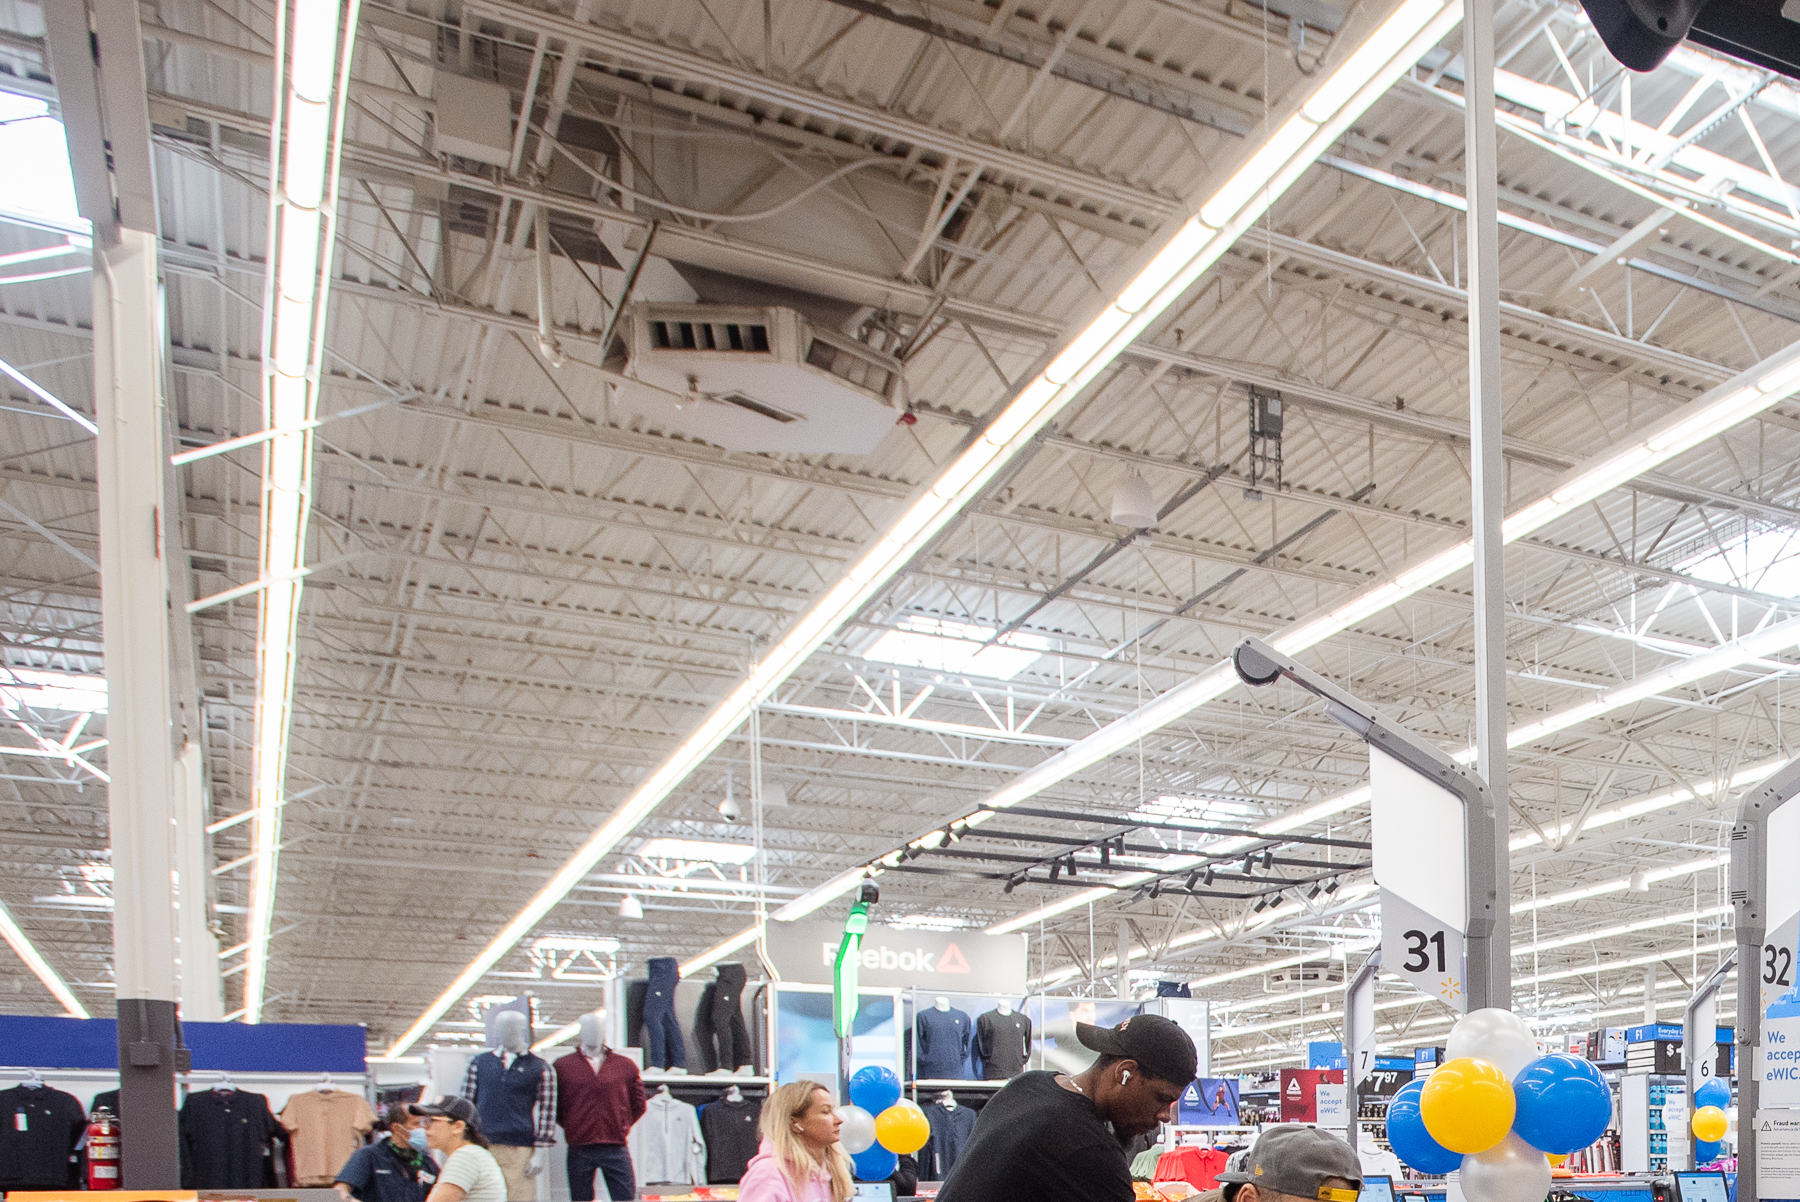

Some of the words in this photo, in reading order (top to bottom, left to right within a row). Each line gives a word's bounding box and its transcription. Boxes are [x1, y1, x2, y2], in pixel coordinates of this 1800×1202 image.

[822, 942, 935, 972] Rebok
[1403, 930, 1446, 973] 31
[1763, 944, 1791, 986] 32
[1636, 1029, 1643, 1040] F1
[1767, 1030, 1786, 1043] We
[1361, 1051, 1368, 1069] 7
[1421, 1051, 1429, 1060] F1
[1335, 1059, 1341, 1067] F1
[1701, 1060, 1709, 1077] 6
[1320, 1098, 1342, 1106] accept
[1320, 1107, 1340, 1115] eWIC.
